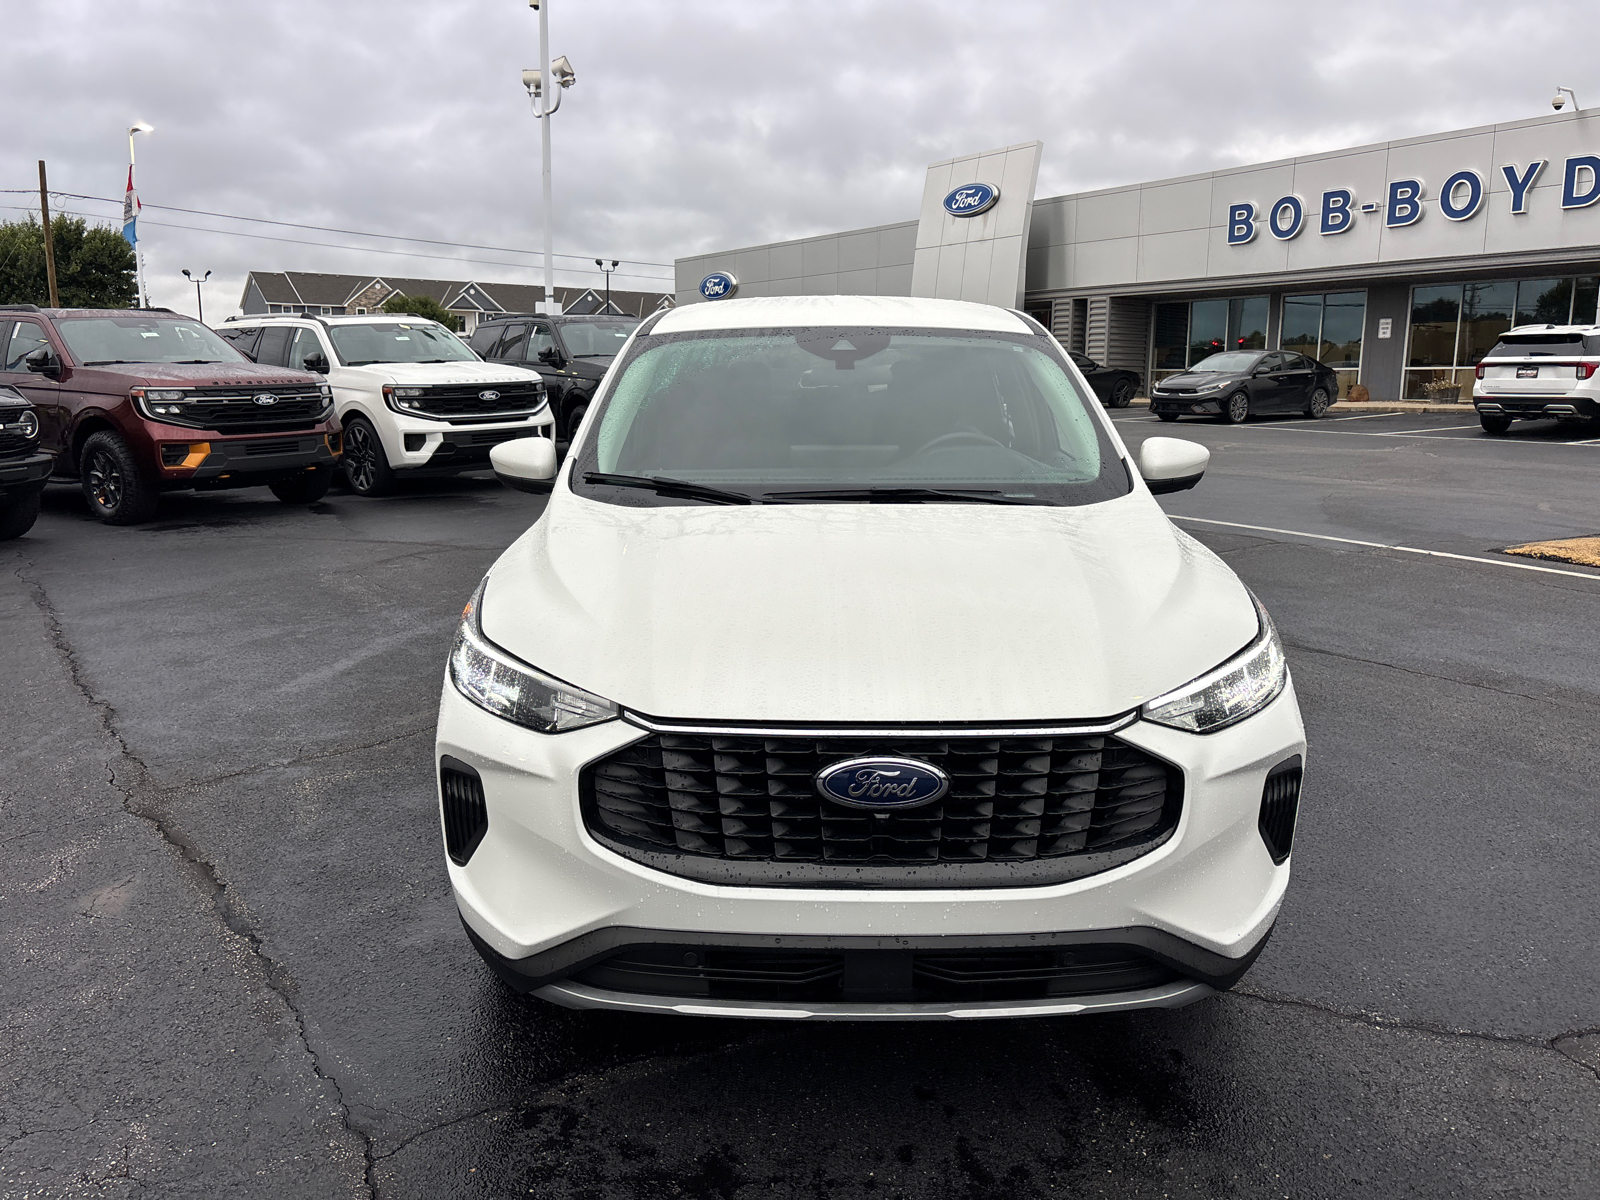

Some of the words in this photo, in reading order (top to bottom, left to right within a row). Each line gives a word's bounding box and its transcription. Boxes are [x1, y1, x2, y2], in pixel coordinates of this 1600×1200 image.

[952, 188, 983, 209] Ford
[1227, 154, 1600, 245] BOB-BOYD
[705, 278, 725, 295] Ford
[848, 768, 918, 798] Ford
